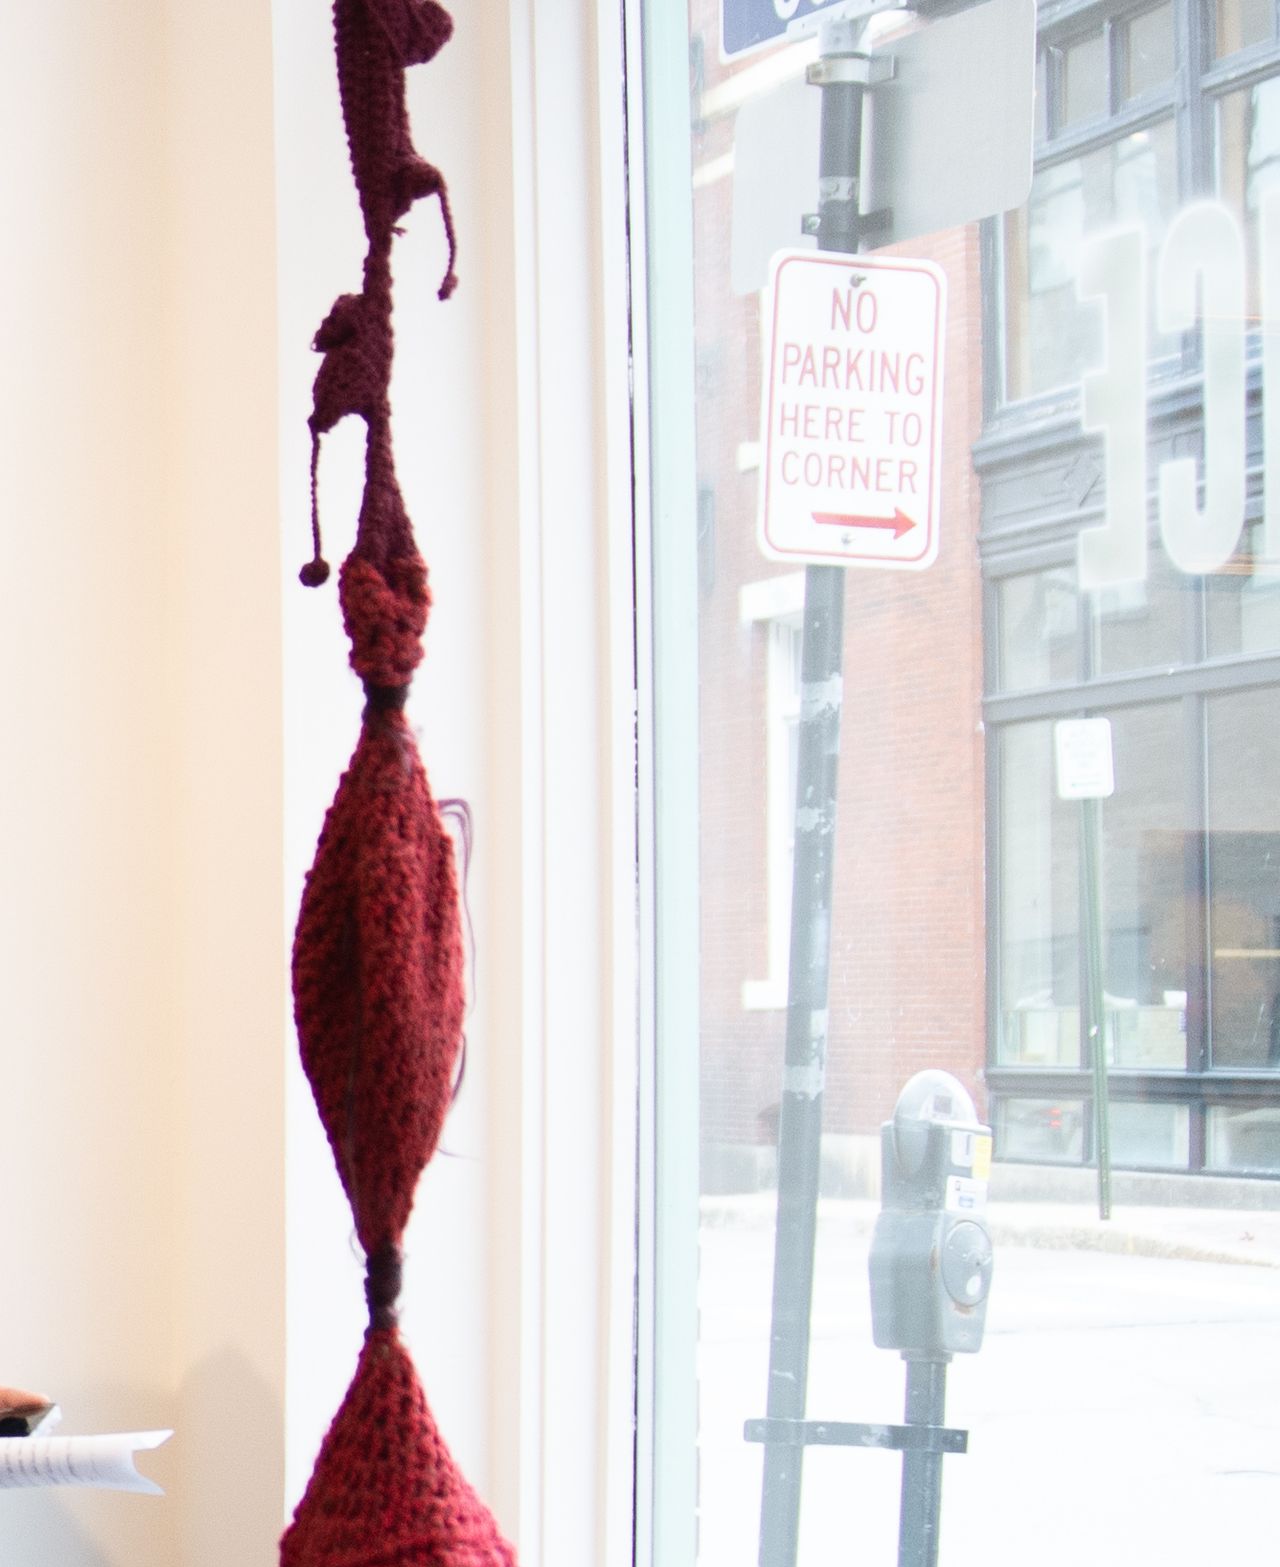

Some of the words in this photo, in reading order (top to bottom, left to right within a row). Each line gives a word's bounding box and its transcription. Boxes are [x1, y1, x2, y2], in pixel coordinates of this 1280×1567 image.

[830, 287, 879, 335] NO
[781, 341, 926, 397] PARKING
[779, 402, 865, 443] HERE
[884, 410, 923, 448] TO
[781, 450, 918, 495] CORNER
